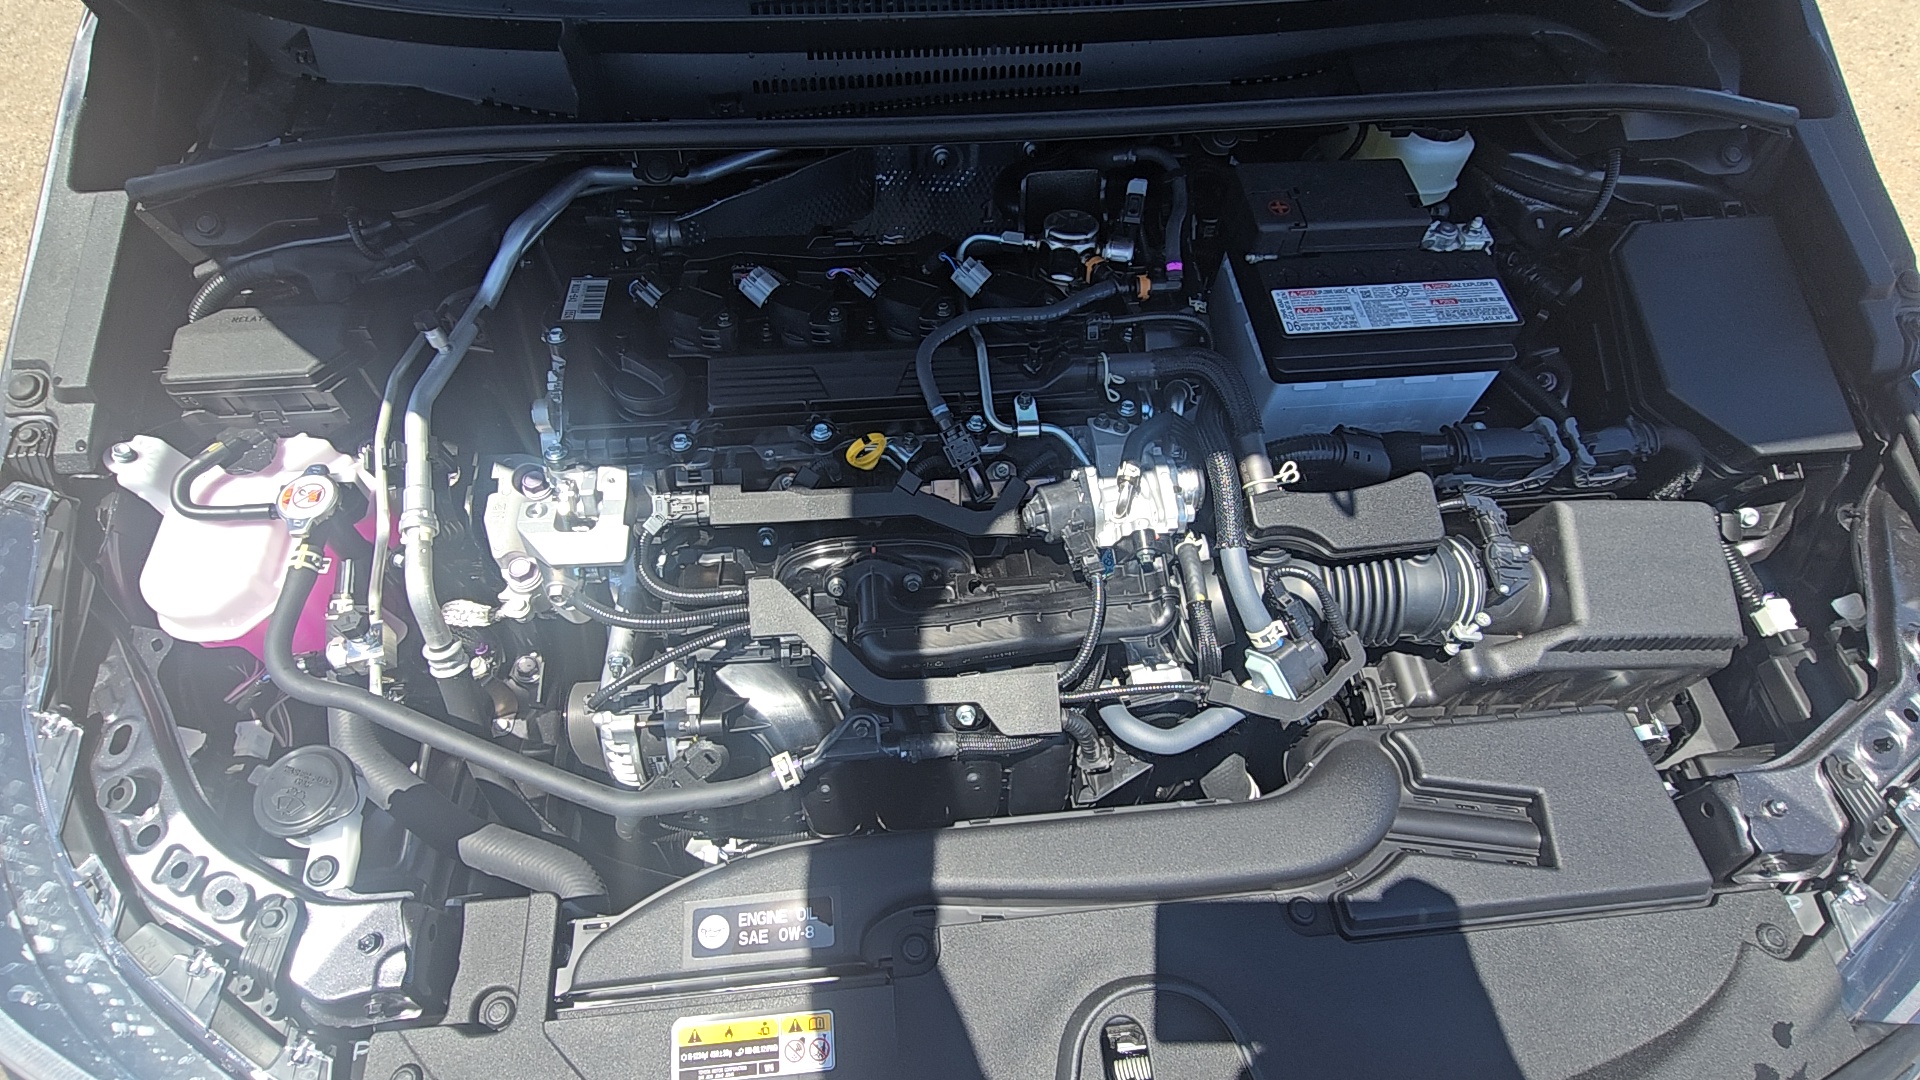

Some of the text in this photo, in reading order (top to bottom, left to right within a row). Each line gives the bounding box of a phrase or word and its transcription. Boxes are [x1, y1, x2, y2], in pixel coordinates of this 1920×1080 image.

[231, 314, 266, 324] RELAY
[1285, 321, 1301, 332] D6
[738, 906, 818, 927] ENGINE OIL
[738, 928, 769, 946] SAE
